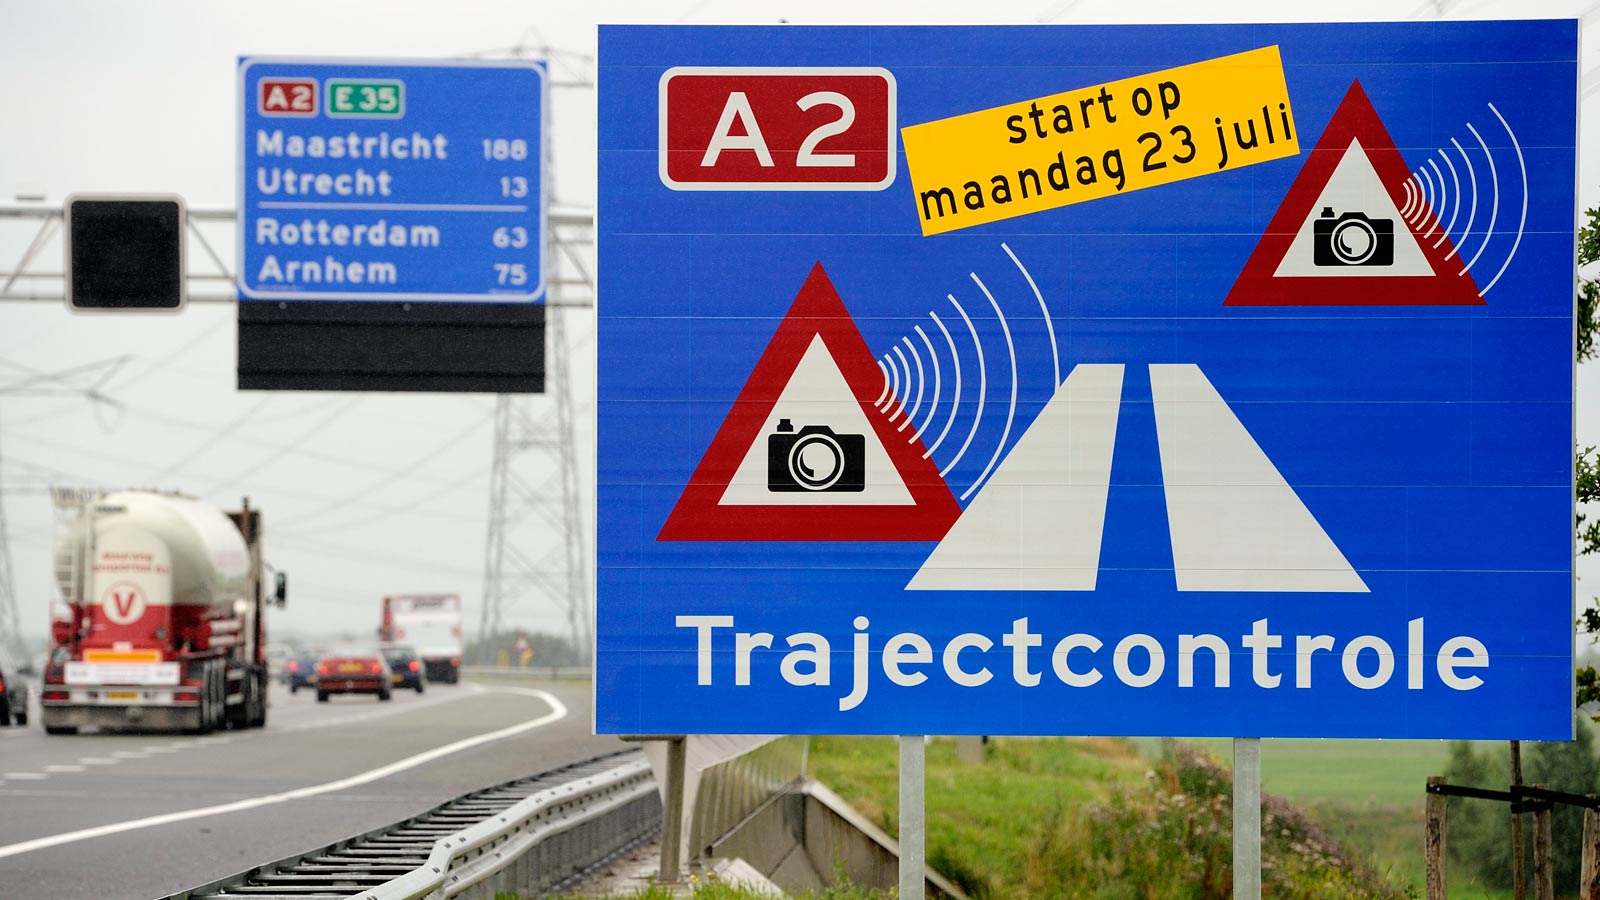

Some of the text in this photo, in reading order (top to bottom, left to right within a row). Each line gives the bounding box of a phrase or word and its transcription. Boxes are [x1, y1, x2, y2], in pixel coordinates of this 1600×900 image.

[265, 85, 312, 111] A2
[1006, 80, 1181, 144] start op
[700, 91, 856, 167] A2
[256, 130, 528, 160] Maastricht 188
[920, 102, 1292, 220] maandag 23 juli
[257, 167, 528, 198] Utrecht 13
[256, 217, 528, 248] Rotterdam 63
[257, 254, 528, 285] Arnhem 75
[113, 592, 135, 618] V
[675, 615, 1489, 712] Trajectcontrole
